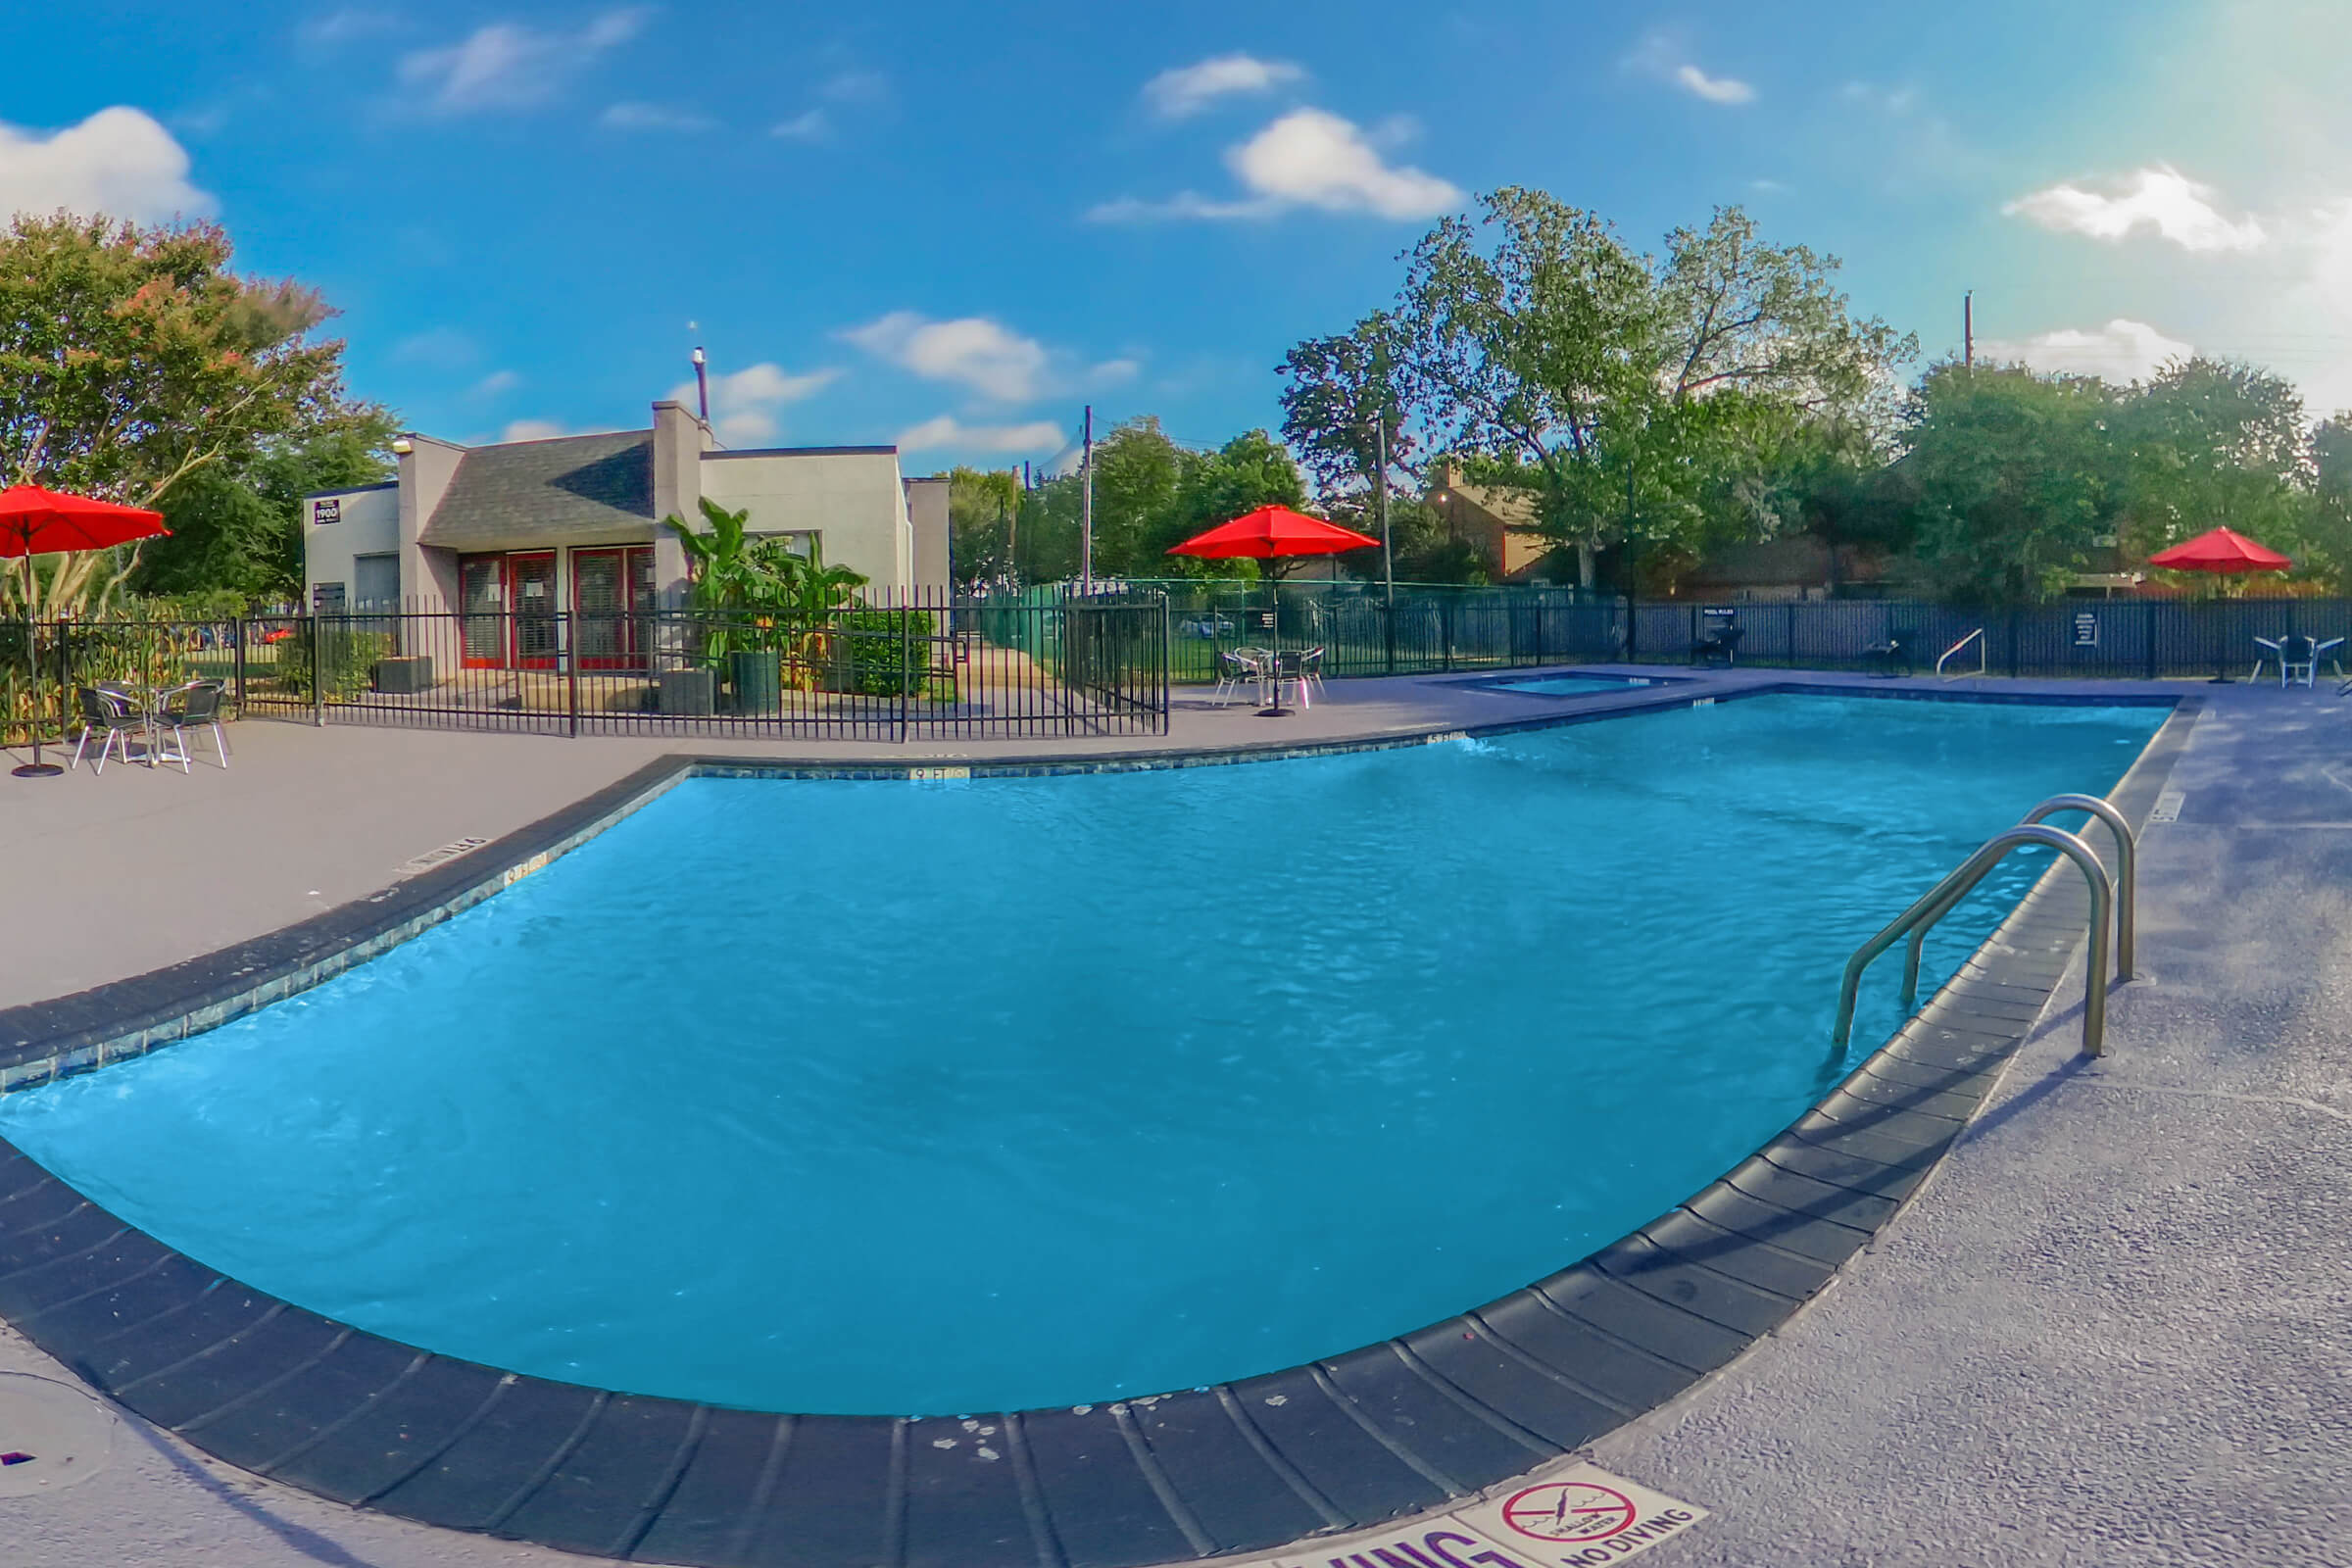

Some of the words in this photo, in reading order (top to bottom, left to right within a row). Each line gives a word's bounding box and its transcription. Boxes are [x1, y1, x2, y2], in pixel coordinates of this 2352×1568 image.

[317, 508, 338, 518] 1900
[1549, 1513, 1603, 1537] SHALLOW
[1579, 1516, 1620, 1535] WATER
[1560, 1547, 1612, 1568] NO
[1601, 1509, 1693, 1553] DIVING
